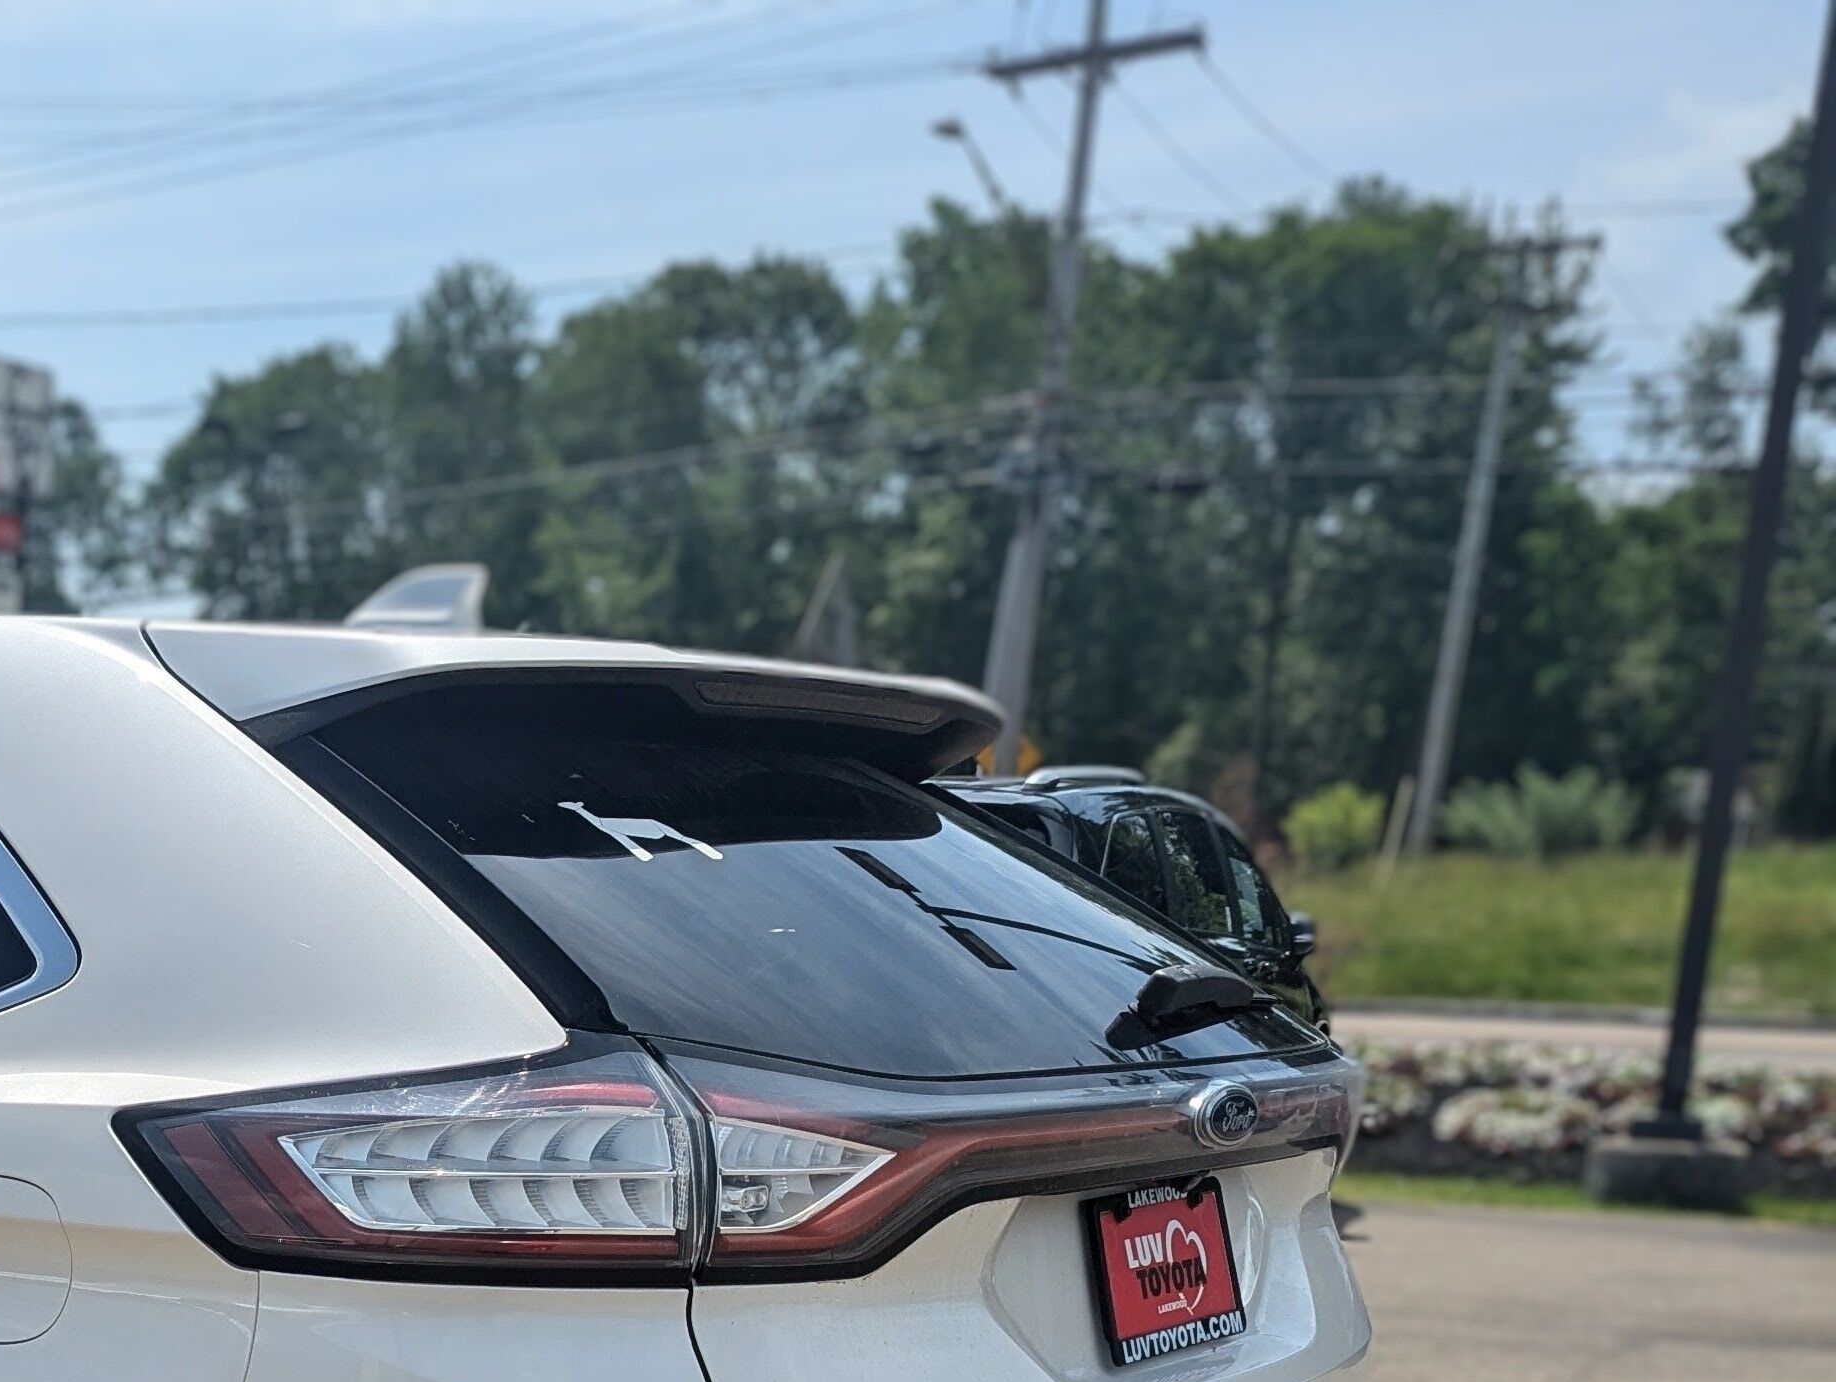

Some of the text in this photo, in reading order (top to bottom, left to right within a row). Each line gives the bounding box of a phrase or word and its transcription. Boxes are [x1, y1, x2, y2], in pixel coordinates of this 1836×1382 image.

[1222, 1099, 1257, 1133] Ford
[1124, 1232, 1164, 1269] LUV
[1136, 1256, 1207, 1299] TOYOTA
[1122, 1311, 1243, 1364] LUVTOYOTA.COM
